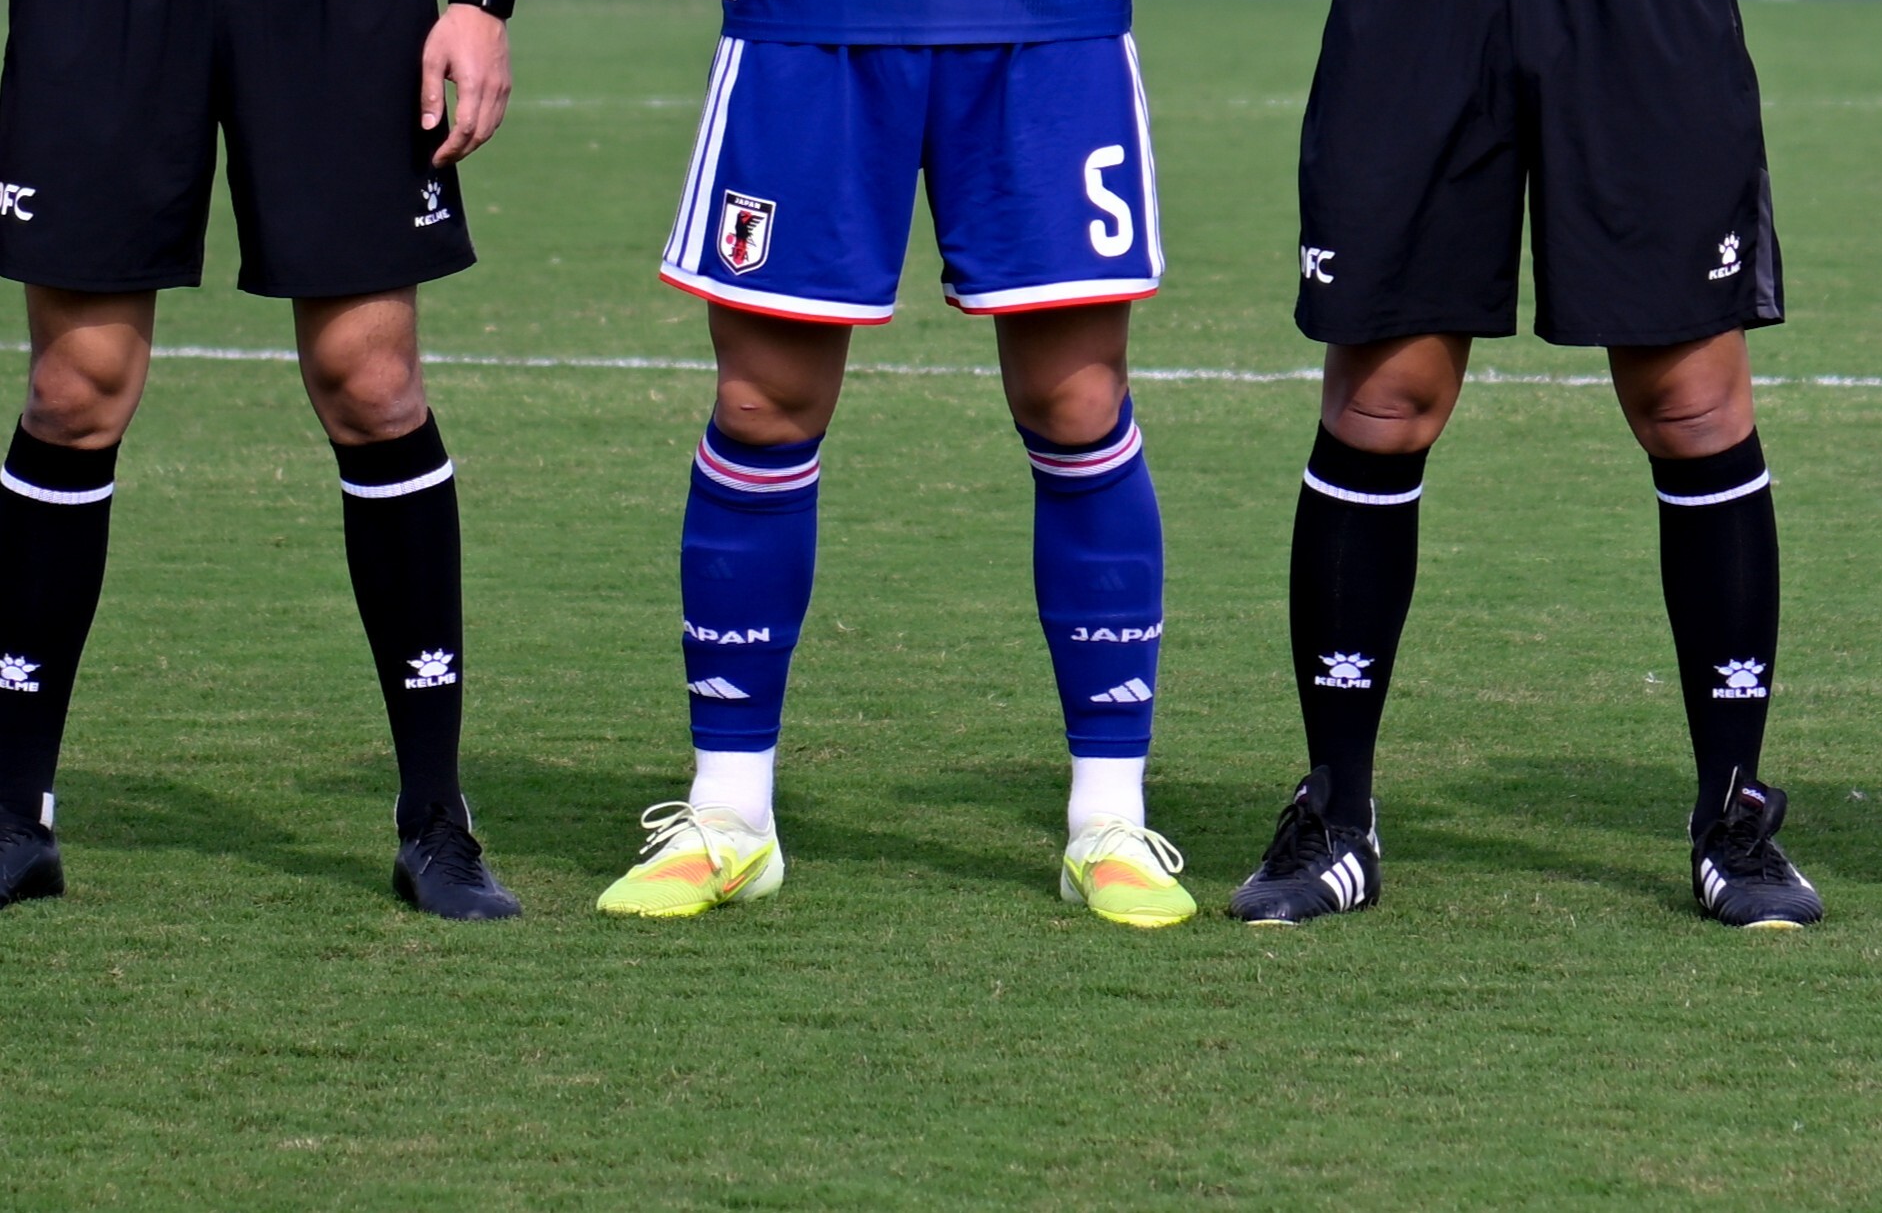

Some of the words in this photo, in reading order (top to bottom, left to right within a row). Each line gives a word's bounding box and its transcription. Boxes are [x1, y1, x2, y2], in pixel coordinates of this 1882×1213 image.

[735, 197, 761, 209] JAPAN
[1084, 144, 1134, 257] 5
[684, 619, 770, 645] APAN
[0, 678, 40, 692] ELME
[405, 672, 457, 689] KELME
[1314, 676, 1372, 689] KELME
[1712, 686, 1767, 698] KELME
